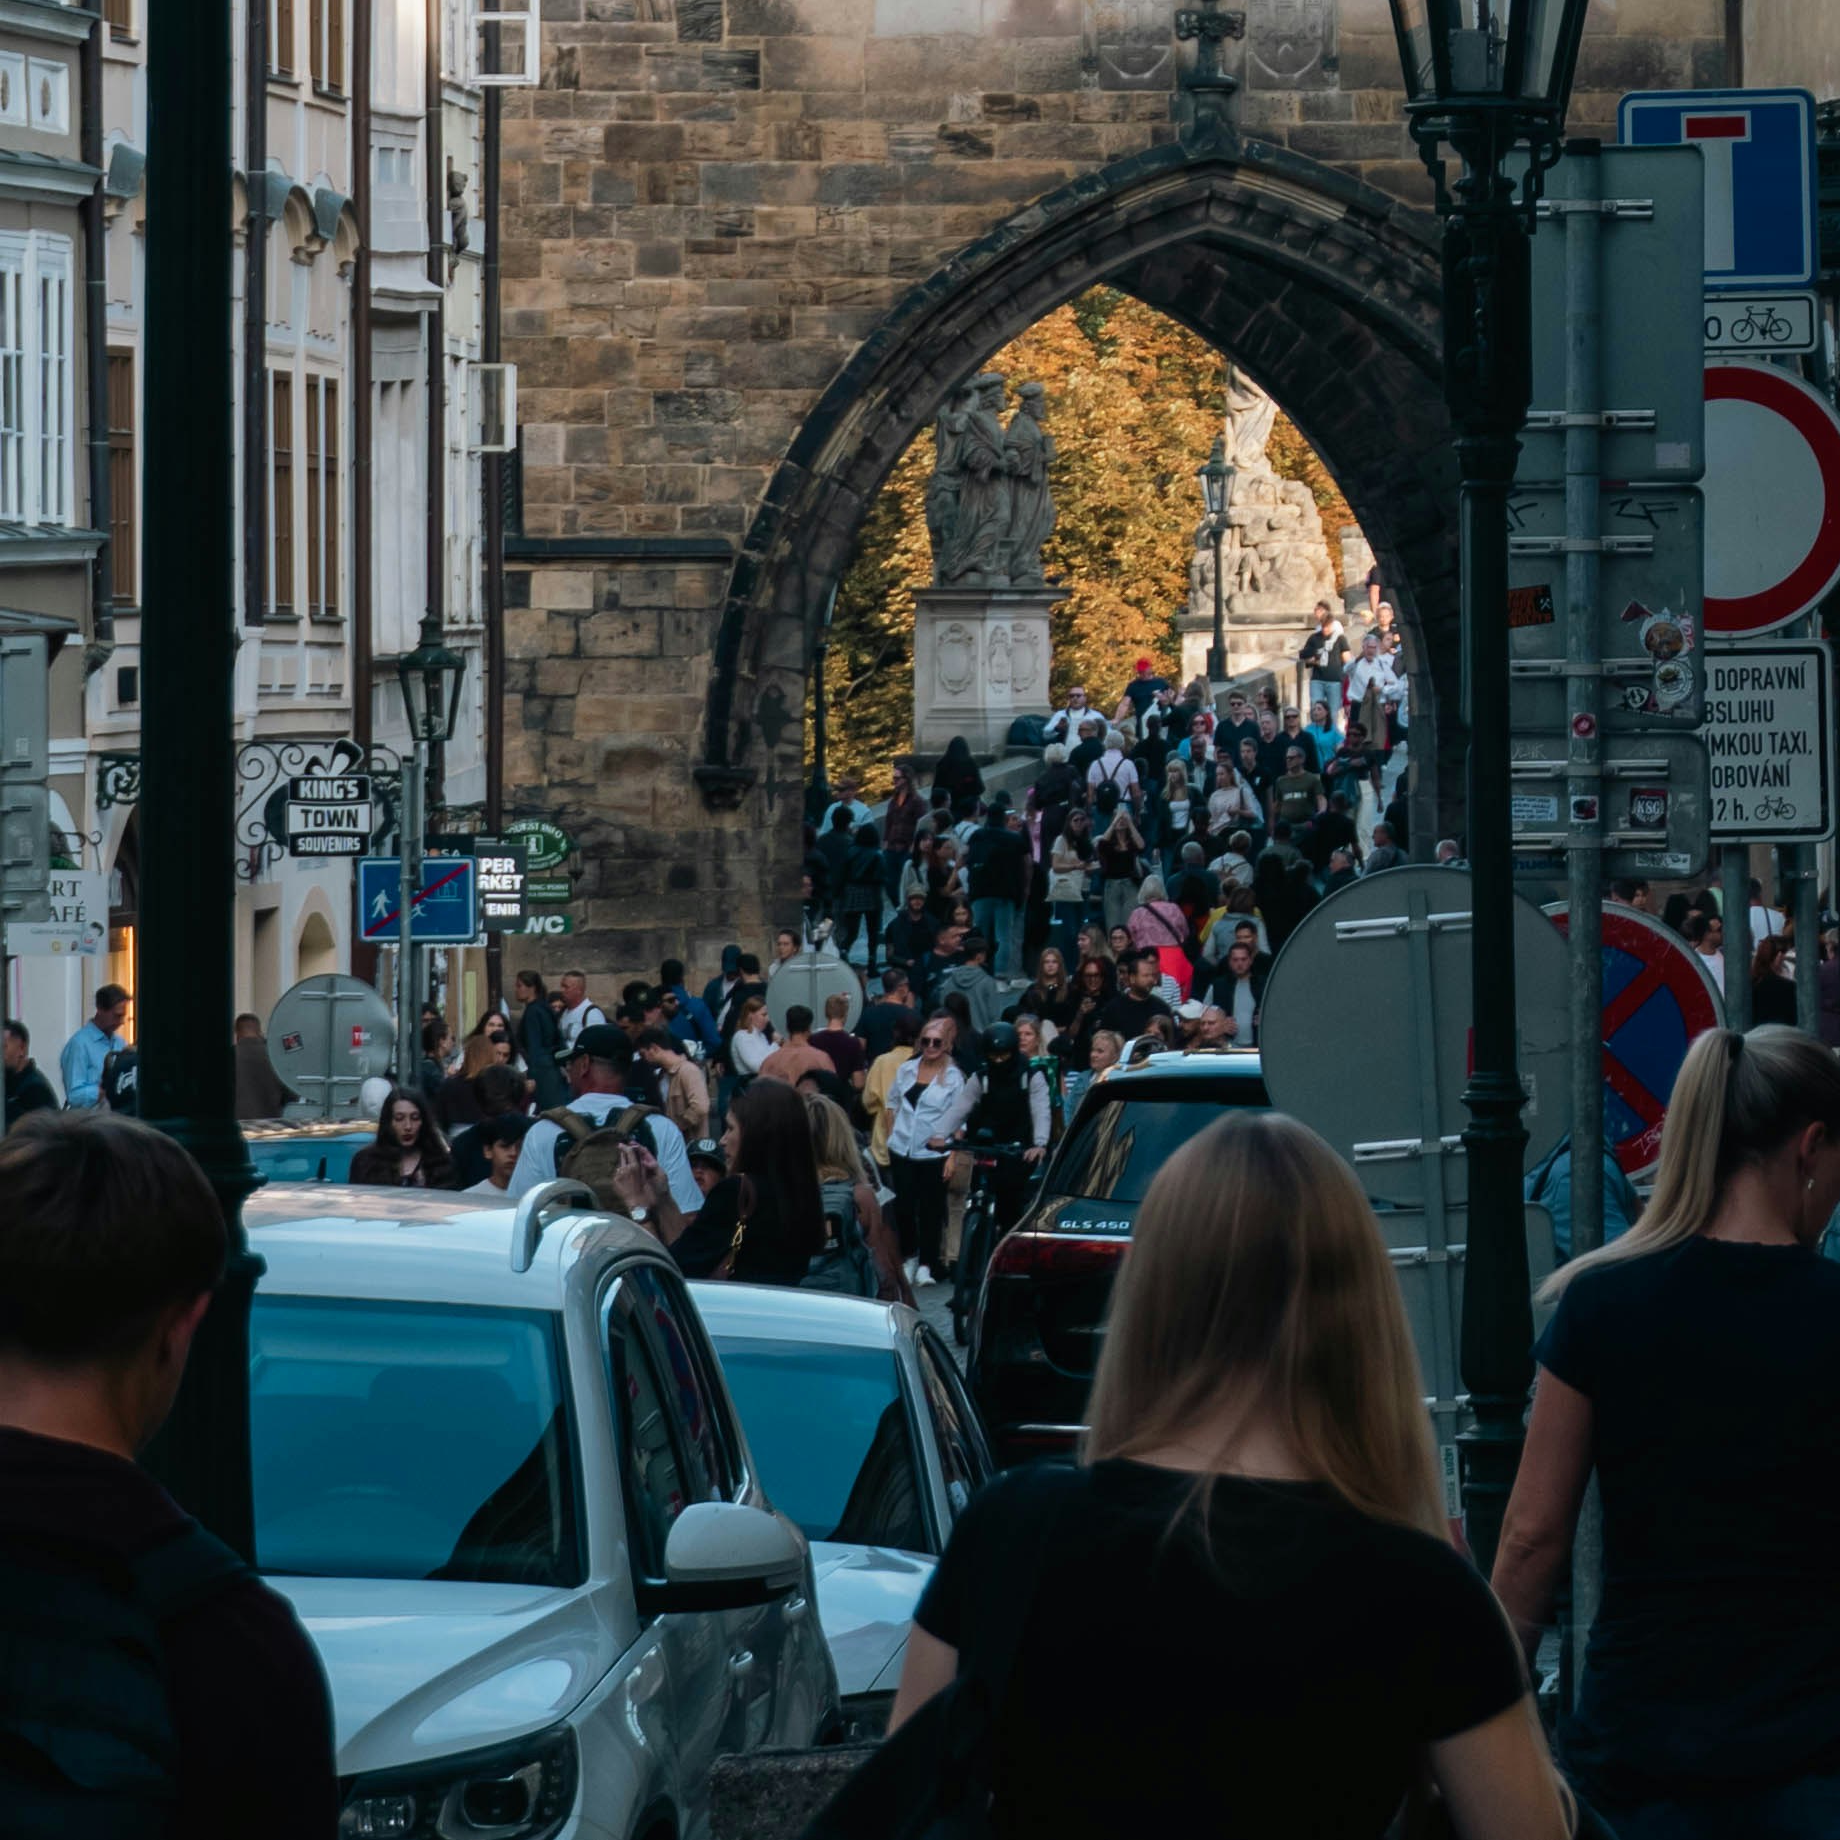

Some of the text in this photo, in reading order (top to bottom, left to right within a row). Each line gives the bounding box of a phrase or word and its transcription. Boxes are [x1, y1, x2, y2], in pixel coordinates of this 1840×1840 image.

[1714, 661, 1807, 691] DOPRAVNÍ
[1703, 700, 1775, 724] BSLUHU
[1702, 728, 1813, 757] ÍMKOU TAXI.
[1711, 759, 1791, 790] OBOVÁNÍ
[299, 779, 360, 800] KING'S
[300, 808, 360, 829] TOWN
[298, 836, 361, 853] SOUVENIRS
[478, 857, 516, 874] PER
[53, 880, 83, 899] RT
[478, 874, 524, 891] RKET
[50, 901, 87, 923] AFÉ
[485, 902, 521, 917] ENIR
[1060, 1220, 1131, 1230] GLS 450
